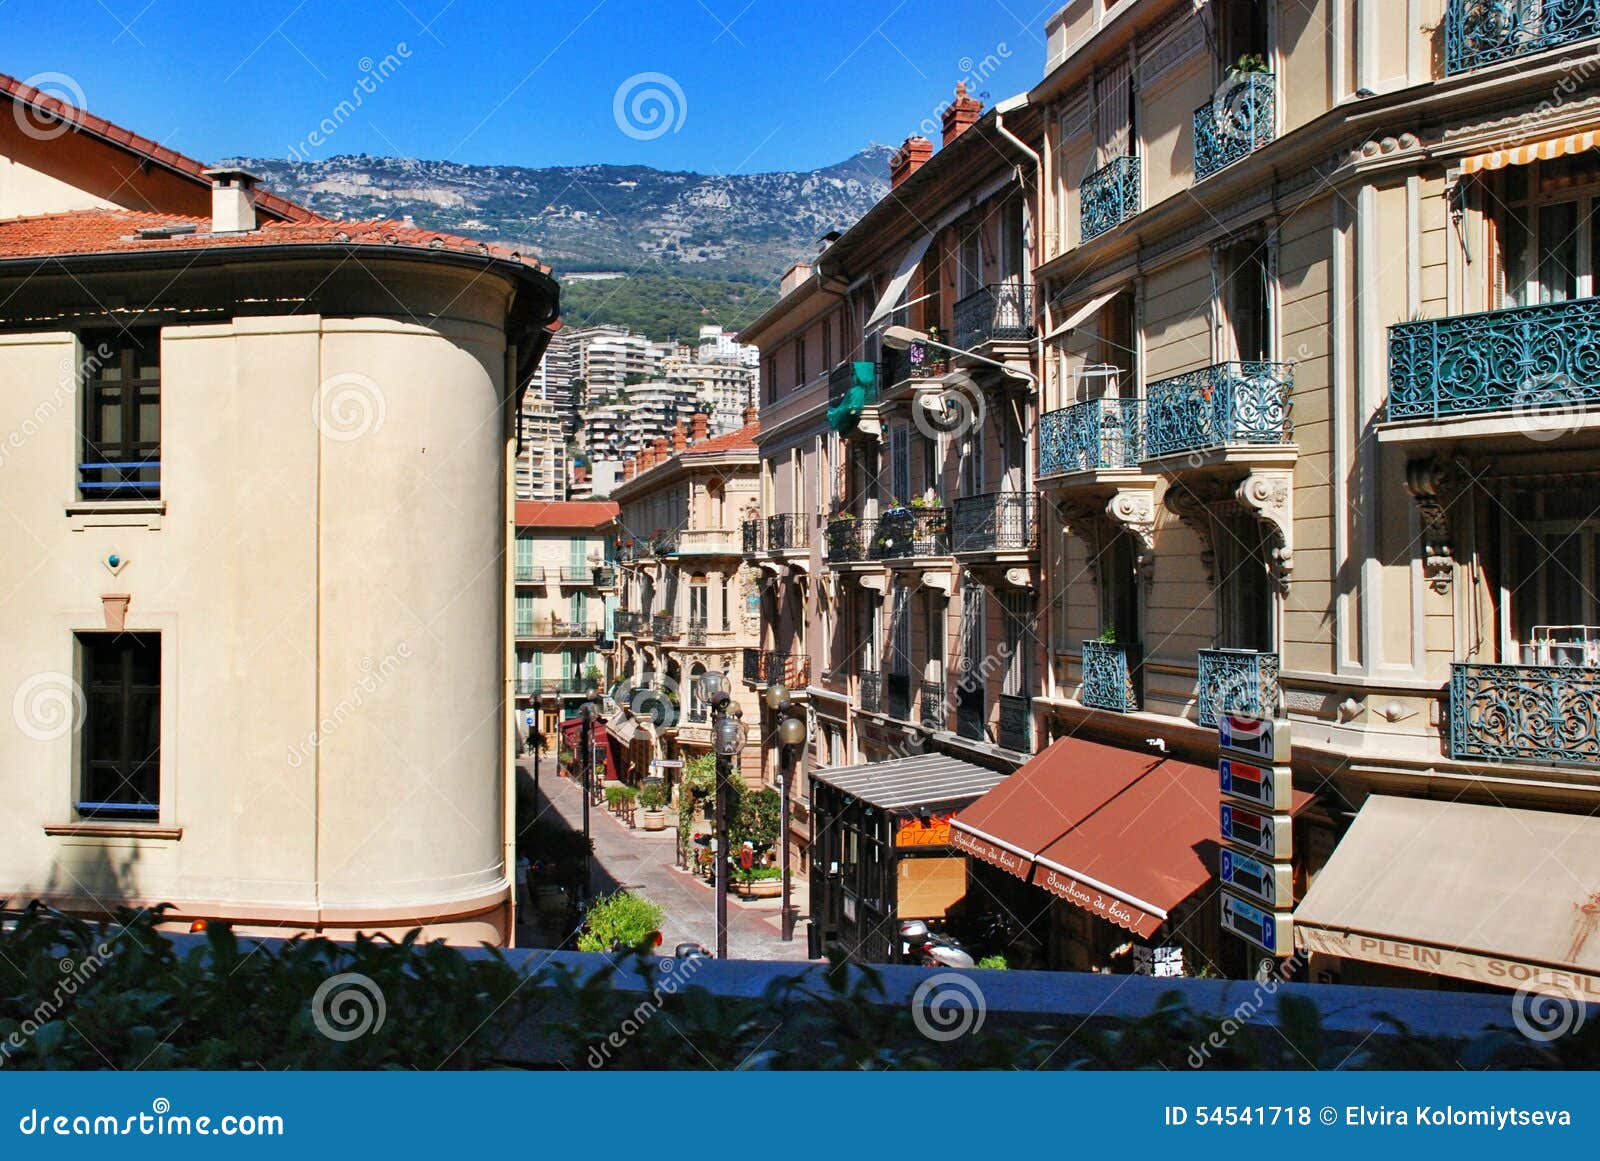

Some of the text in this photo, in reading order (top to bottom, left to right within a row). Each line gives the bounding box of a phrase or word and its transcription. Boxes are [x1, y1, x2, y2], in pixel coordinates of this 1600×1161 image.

[1047, 870, 1090, 903] Touchons
[1093, 896, 1107, 910] du
[1108, 900, 1130, 922] bois
[1360, 937, 1441, 966] PLEIN
[1487, 960, 1600, 995] SOLEIL
